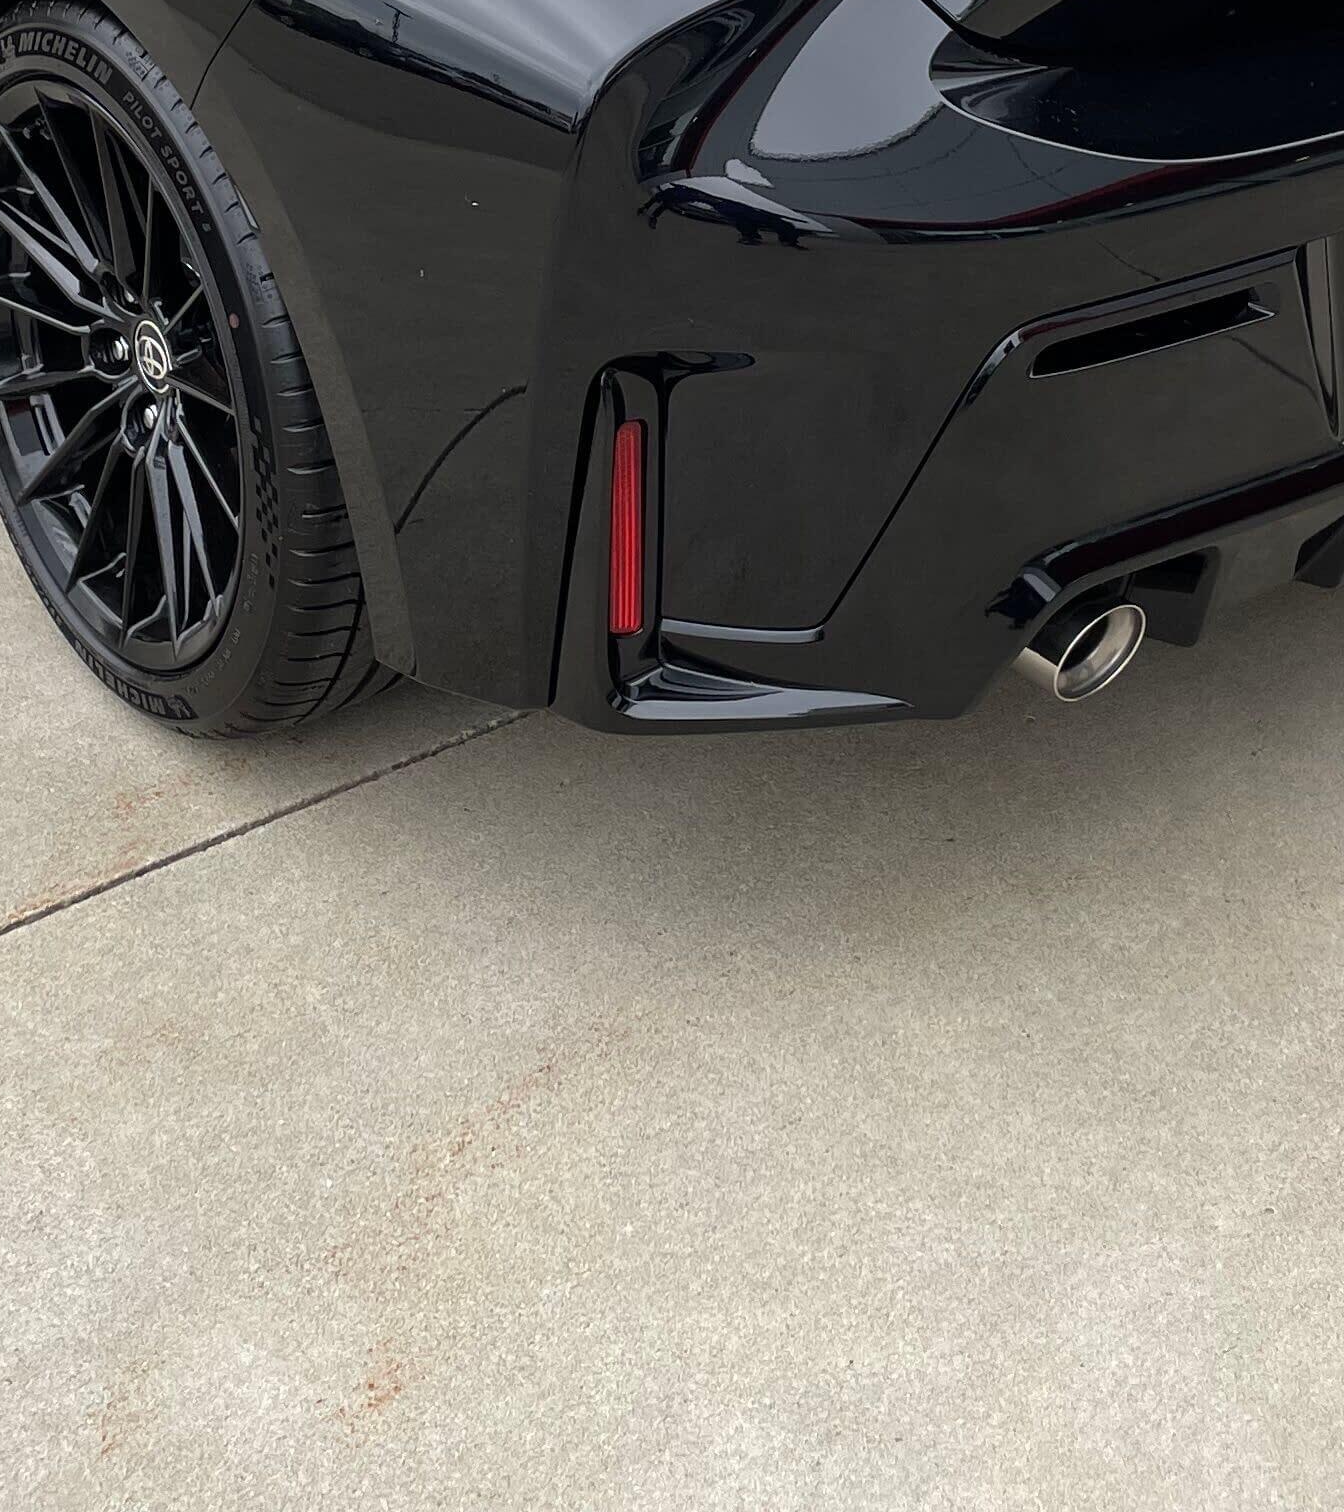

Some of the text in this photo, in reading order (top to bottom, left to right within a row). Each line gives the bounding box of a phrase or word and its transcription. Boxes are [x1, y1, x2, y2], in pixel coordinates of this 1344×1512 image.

[17, 30, 113, 85] MICHELIN
[122, 90, 161, 138] PILOT
[160, 144, 205, 215] SPORT
[74, 640, 167, 716] MICHELIN
